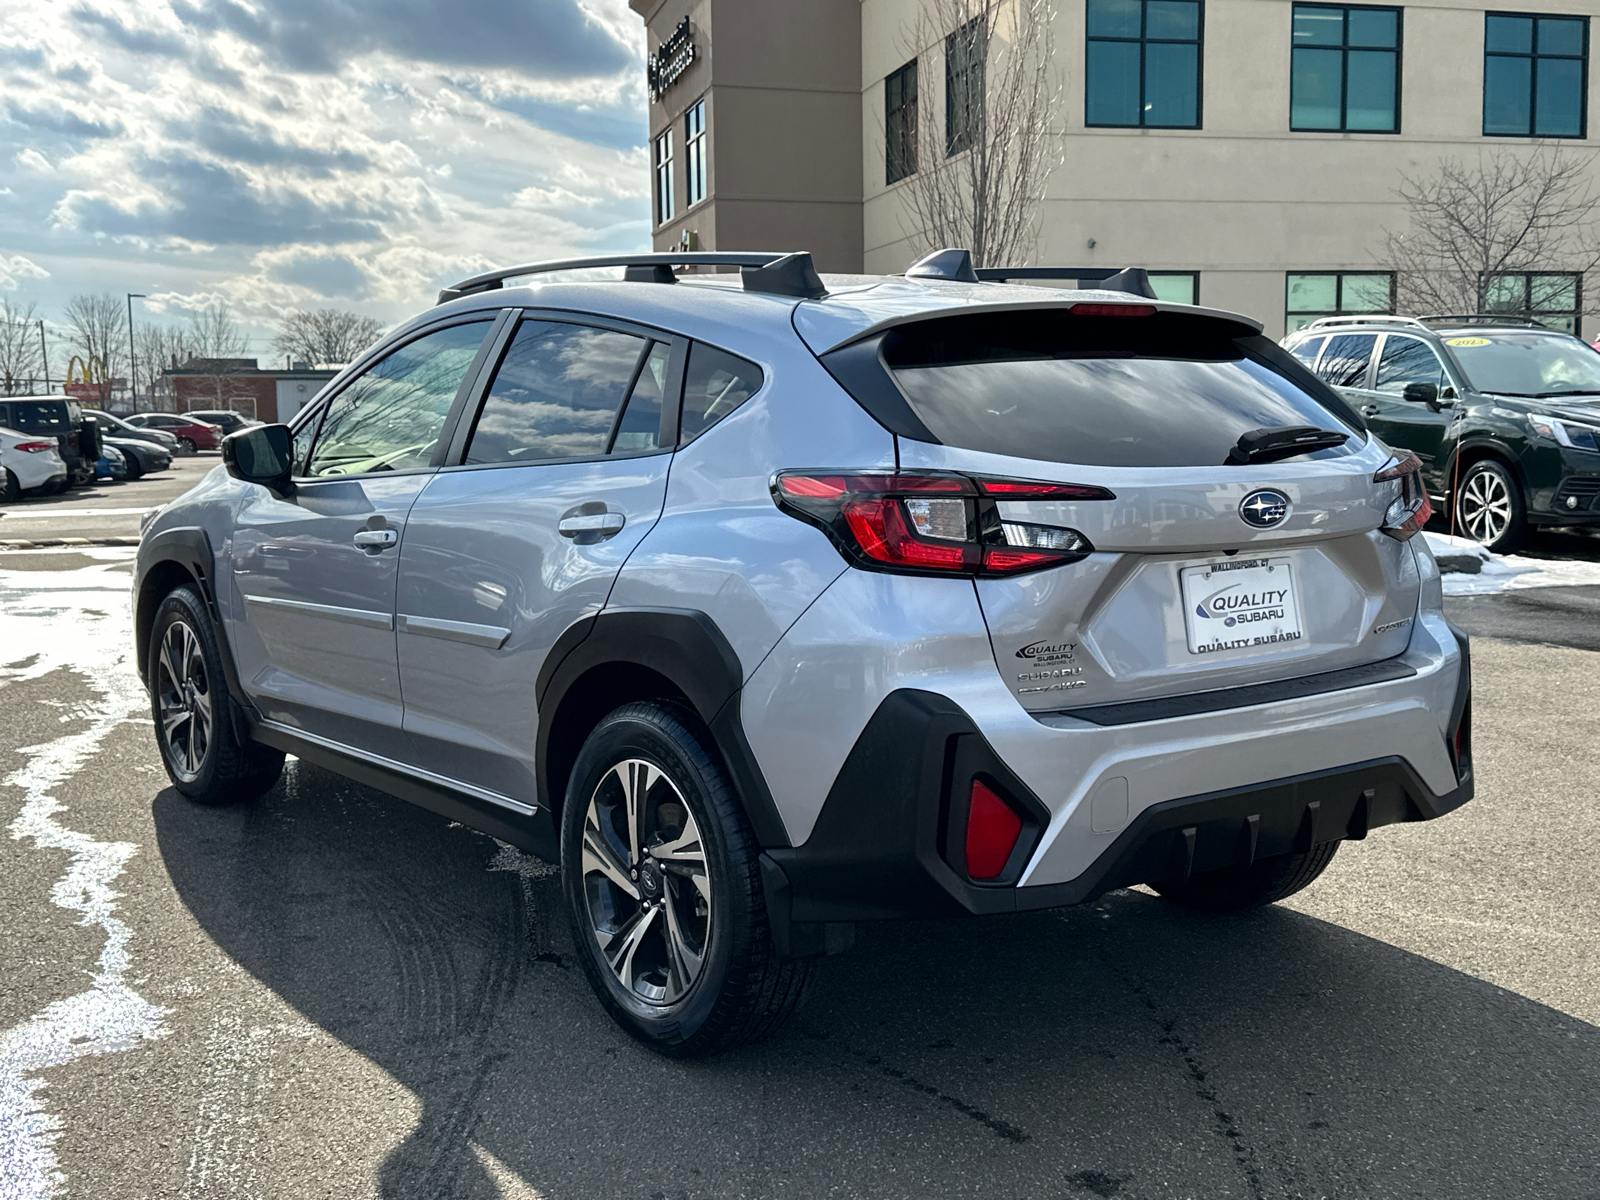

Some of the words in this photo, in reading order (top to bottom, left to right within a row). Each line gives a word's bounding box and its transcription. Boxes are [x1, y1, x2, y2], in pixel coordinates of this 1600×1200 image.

[1213, 590, 1287, 610] QUALITY
[1237, 609, 1284, 623] SUBARU
[1027, 644, 1077, 654] QUALITY
[1198, 639, 1250, 653] QUALITY
[1253, 631, 1301, 646] SUBARU
[1037, 654, 1072, 662] SUBARU
[1018, 667, 1081, 681] SUBARU
